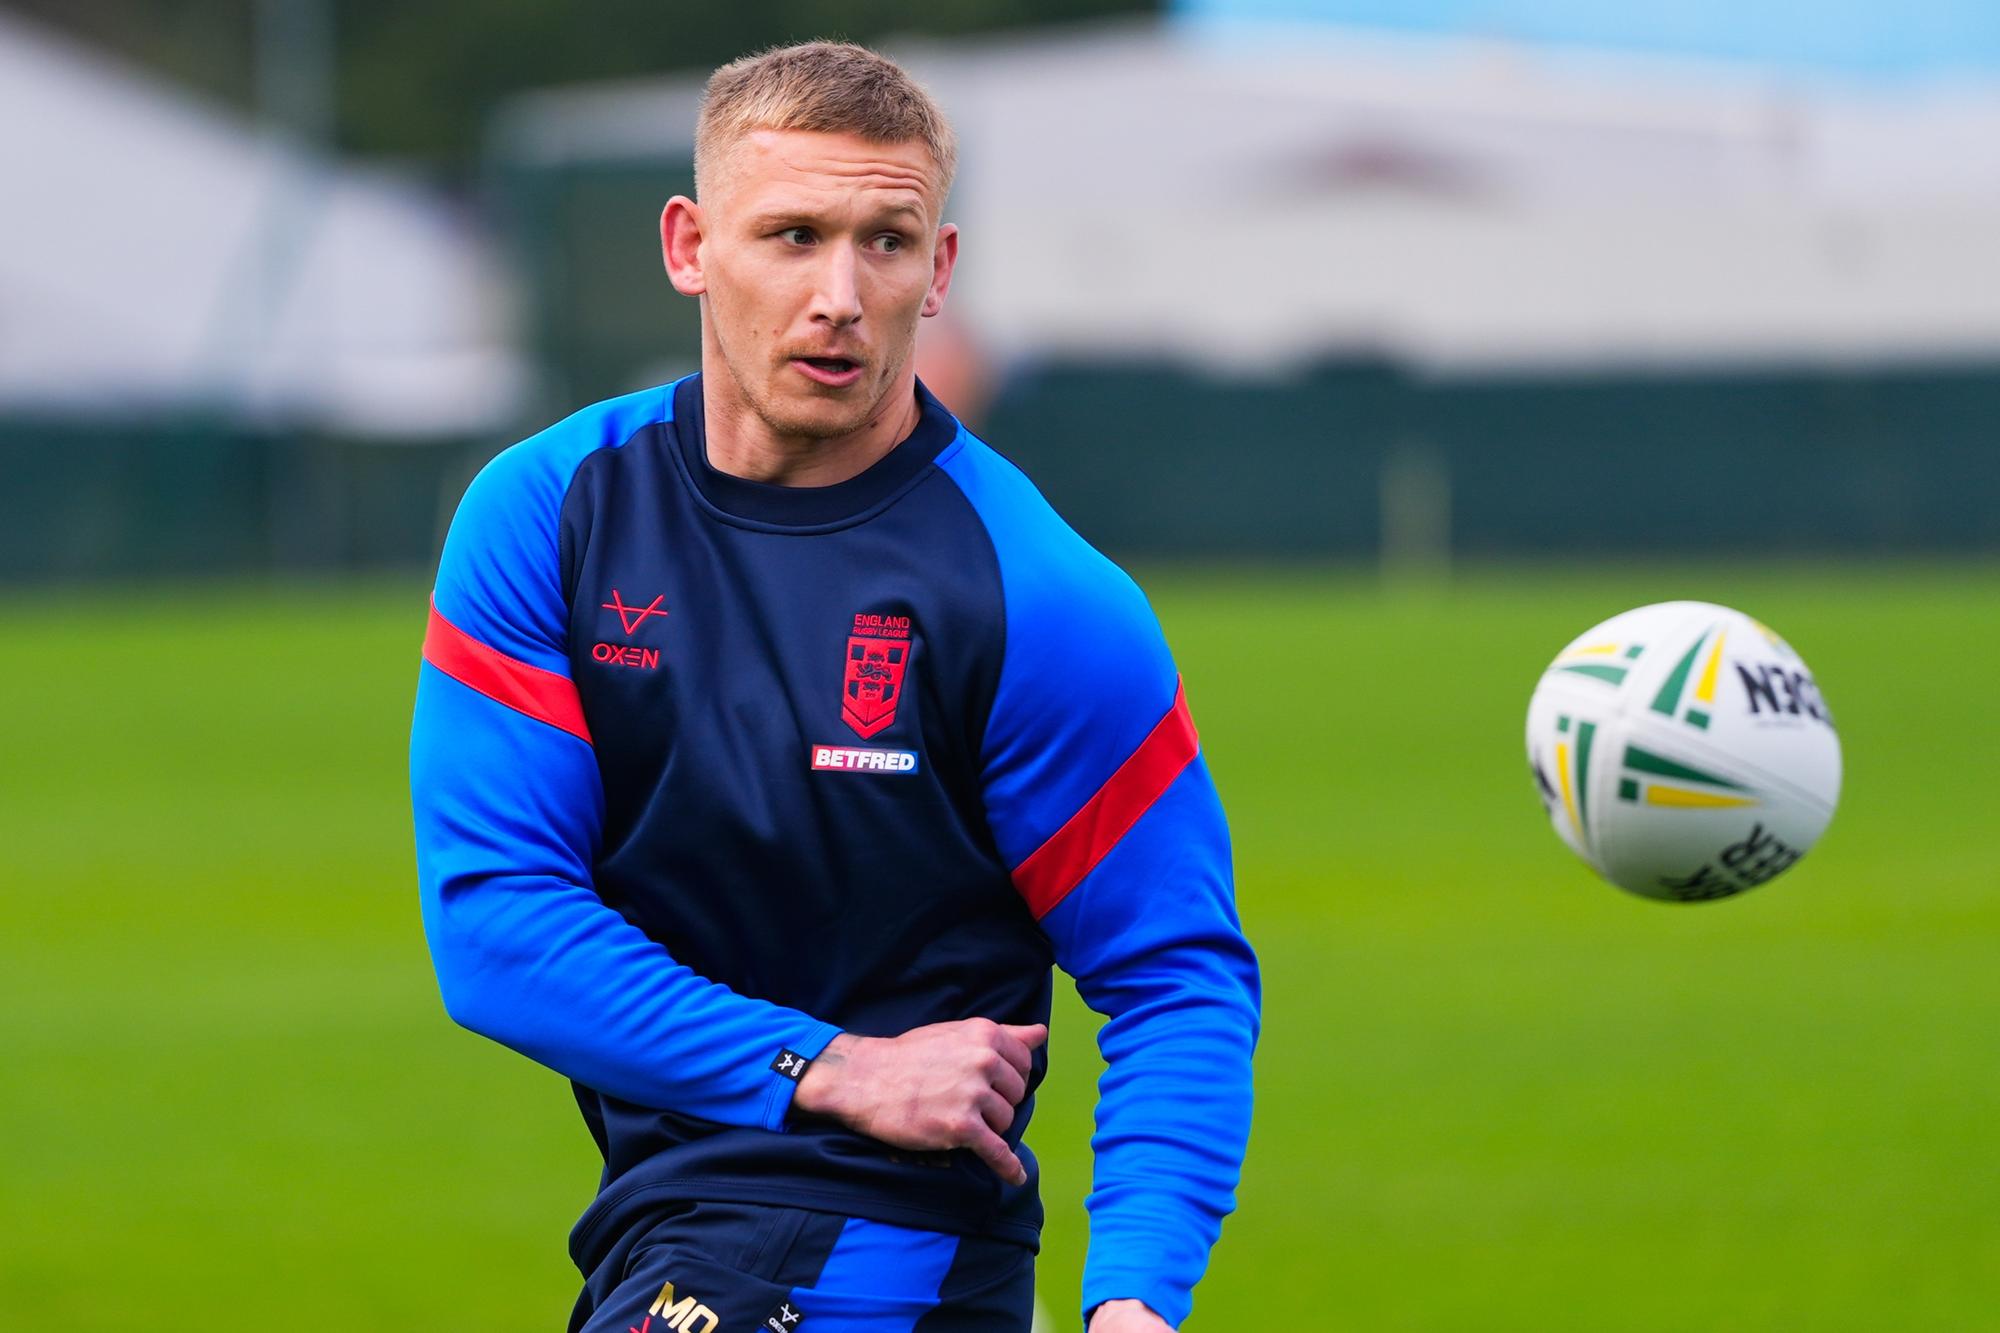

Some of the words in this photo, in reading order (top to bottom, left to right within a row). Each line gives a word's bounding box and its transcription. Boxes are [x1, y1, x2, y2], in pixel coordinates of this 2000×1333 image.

[854, 613, 910, 628] ENGLAND
[879, 628, 909, 638] LEAGUE
[592, 643, 659, 669] OXEN
[815, 749, 915, 771] BETFRED
